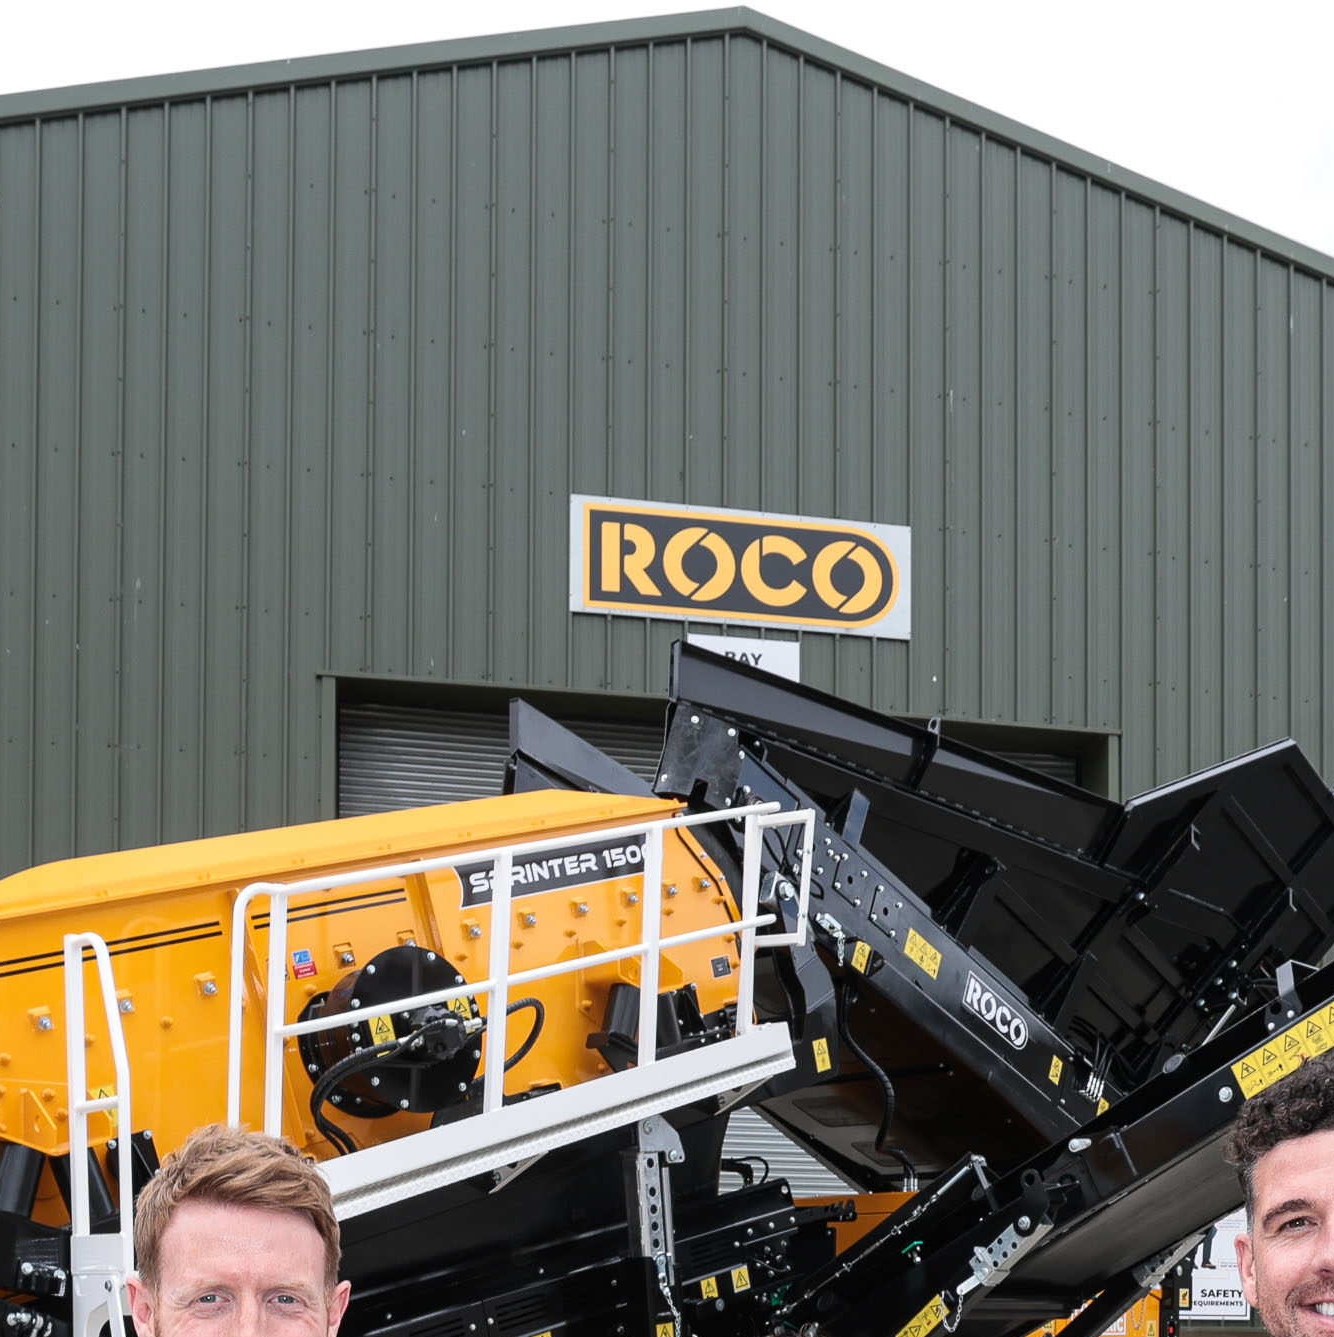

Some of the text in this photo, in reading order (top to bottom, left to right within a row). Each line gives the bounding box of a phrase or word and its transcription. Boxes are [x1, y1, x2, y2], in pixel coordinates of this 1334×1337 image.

[601, 521, 883, 614] ROCO
[966, 977, 1026, 1046] ROCO
[1200, 1288, 1243, 1298] SAFETY
